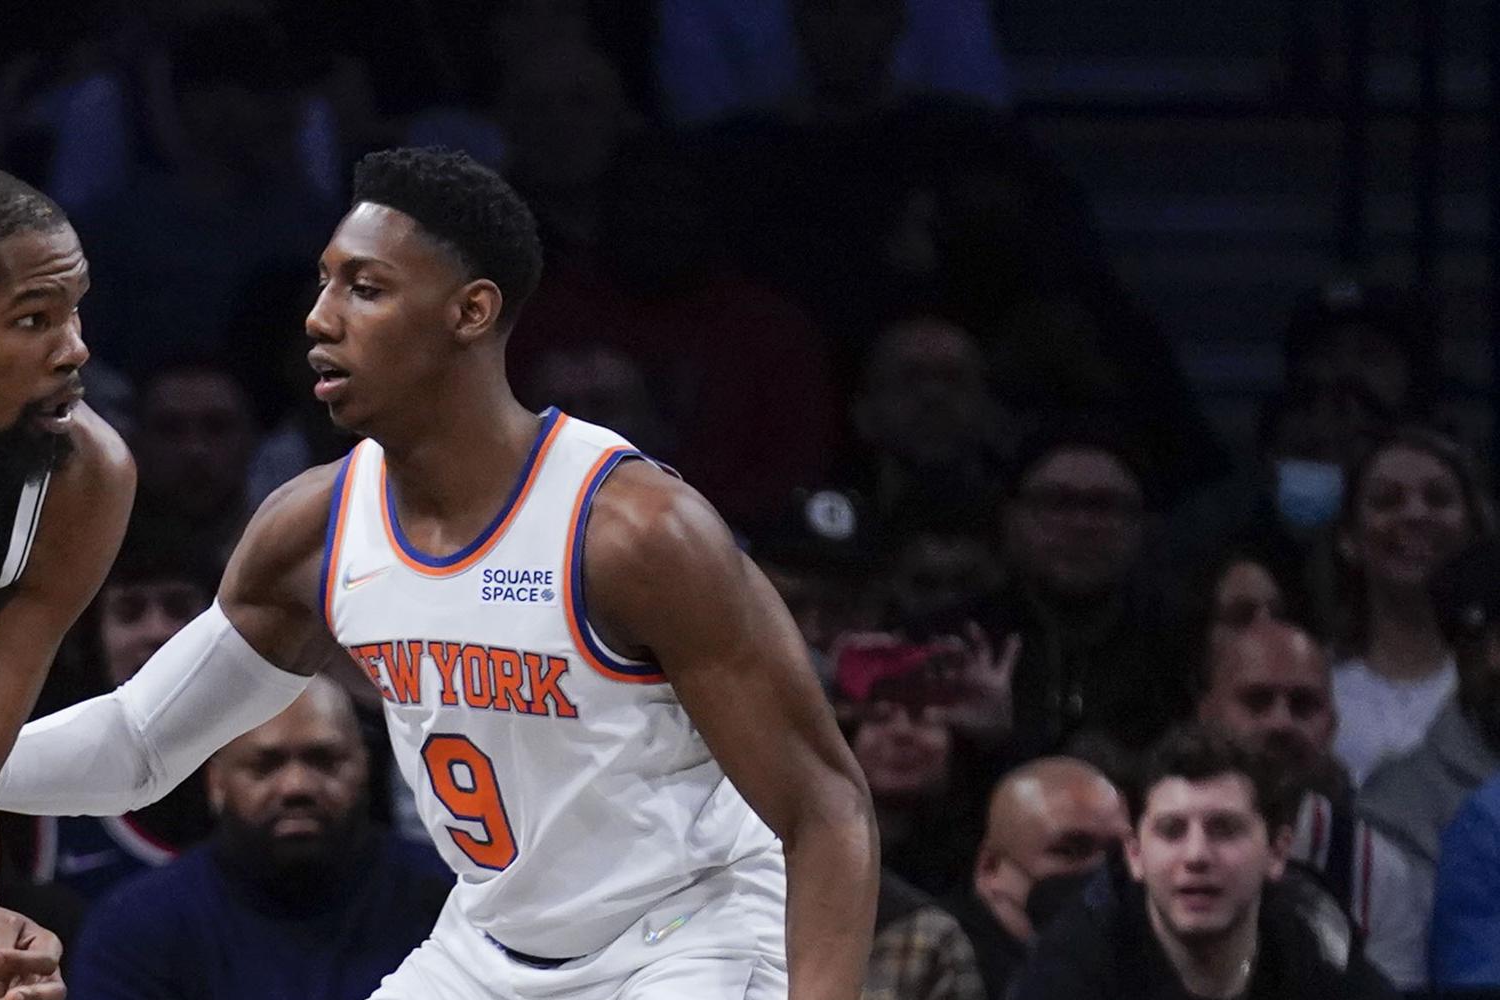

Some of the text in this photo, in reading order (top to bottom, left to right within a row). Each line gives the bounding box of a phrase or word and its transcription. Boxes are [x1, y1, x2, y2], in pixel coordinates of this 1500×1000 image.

[481, 586, 539, 602] SPACE
[483, 568, 553, 585] SQUARE
[350, 640, 579, 719] EW YORK
[419, 732, 520, 873] 9
